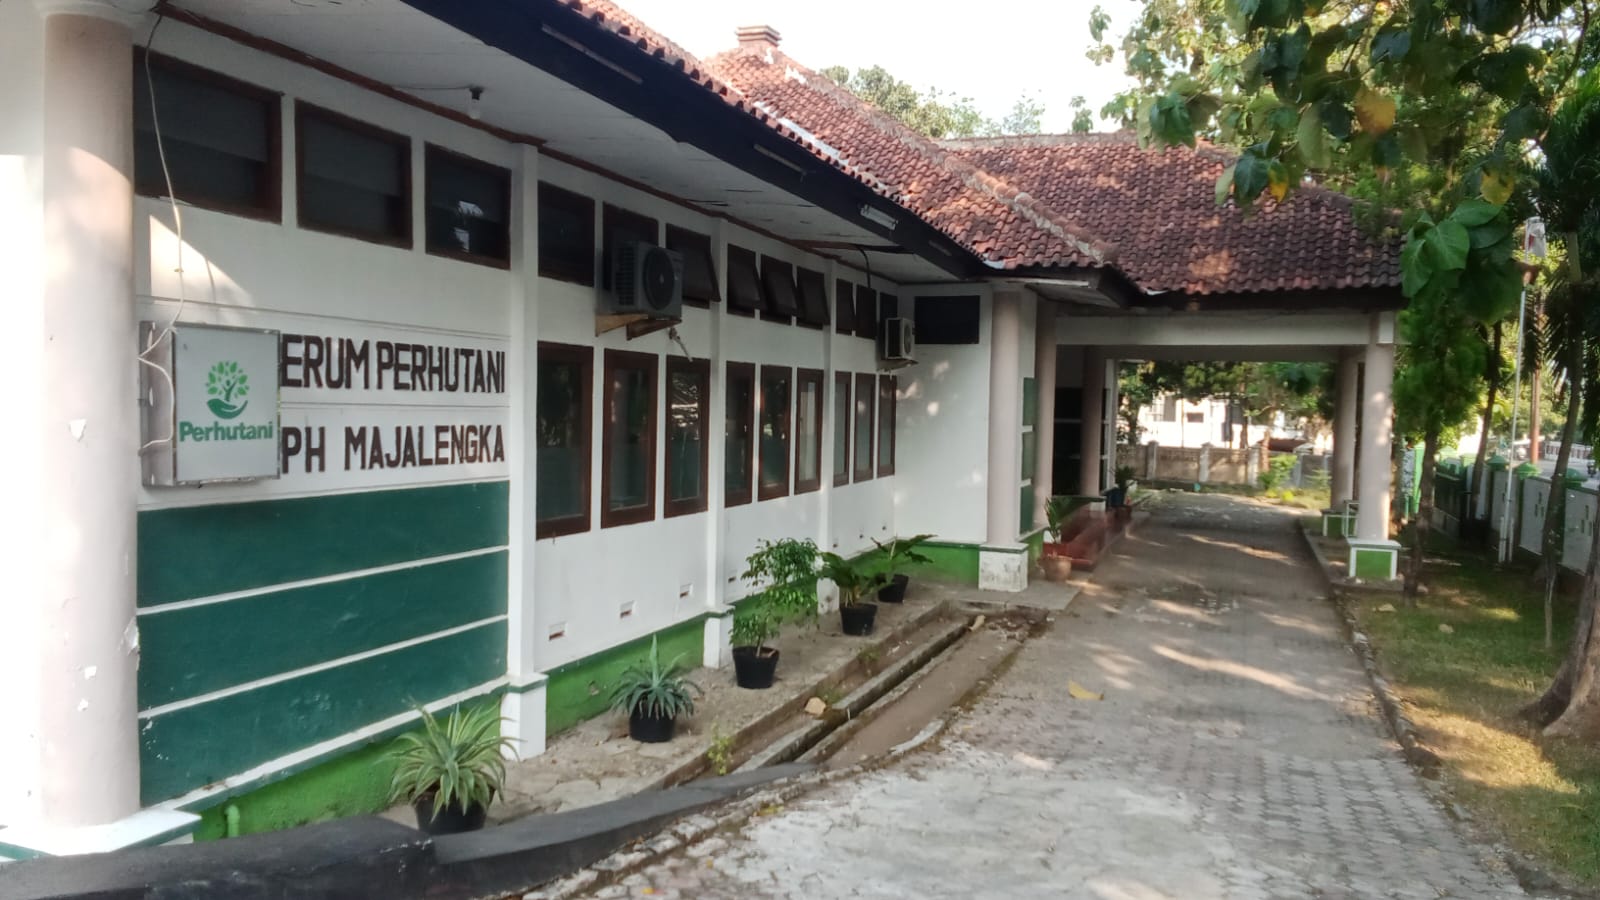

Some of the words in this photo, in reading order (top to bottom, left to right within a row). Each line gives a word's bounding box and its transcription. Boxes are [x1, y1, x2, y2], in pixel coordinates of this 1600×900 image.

[281, 334, 370, 389] ERUM
[377, 342, 505, 393] PERHUTANI
[179, 421, 273, 442] Perhutani
[281, 425, 326, 475] PH
[344, 424, 504, 470] MAJALENGKA
